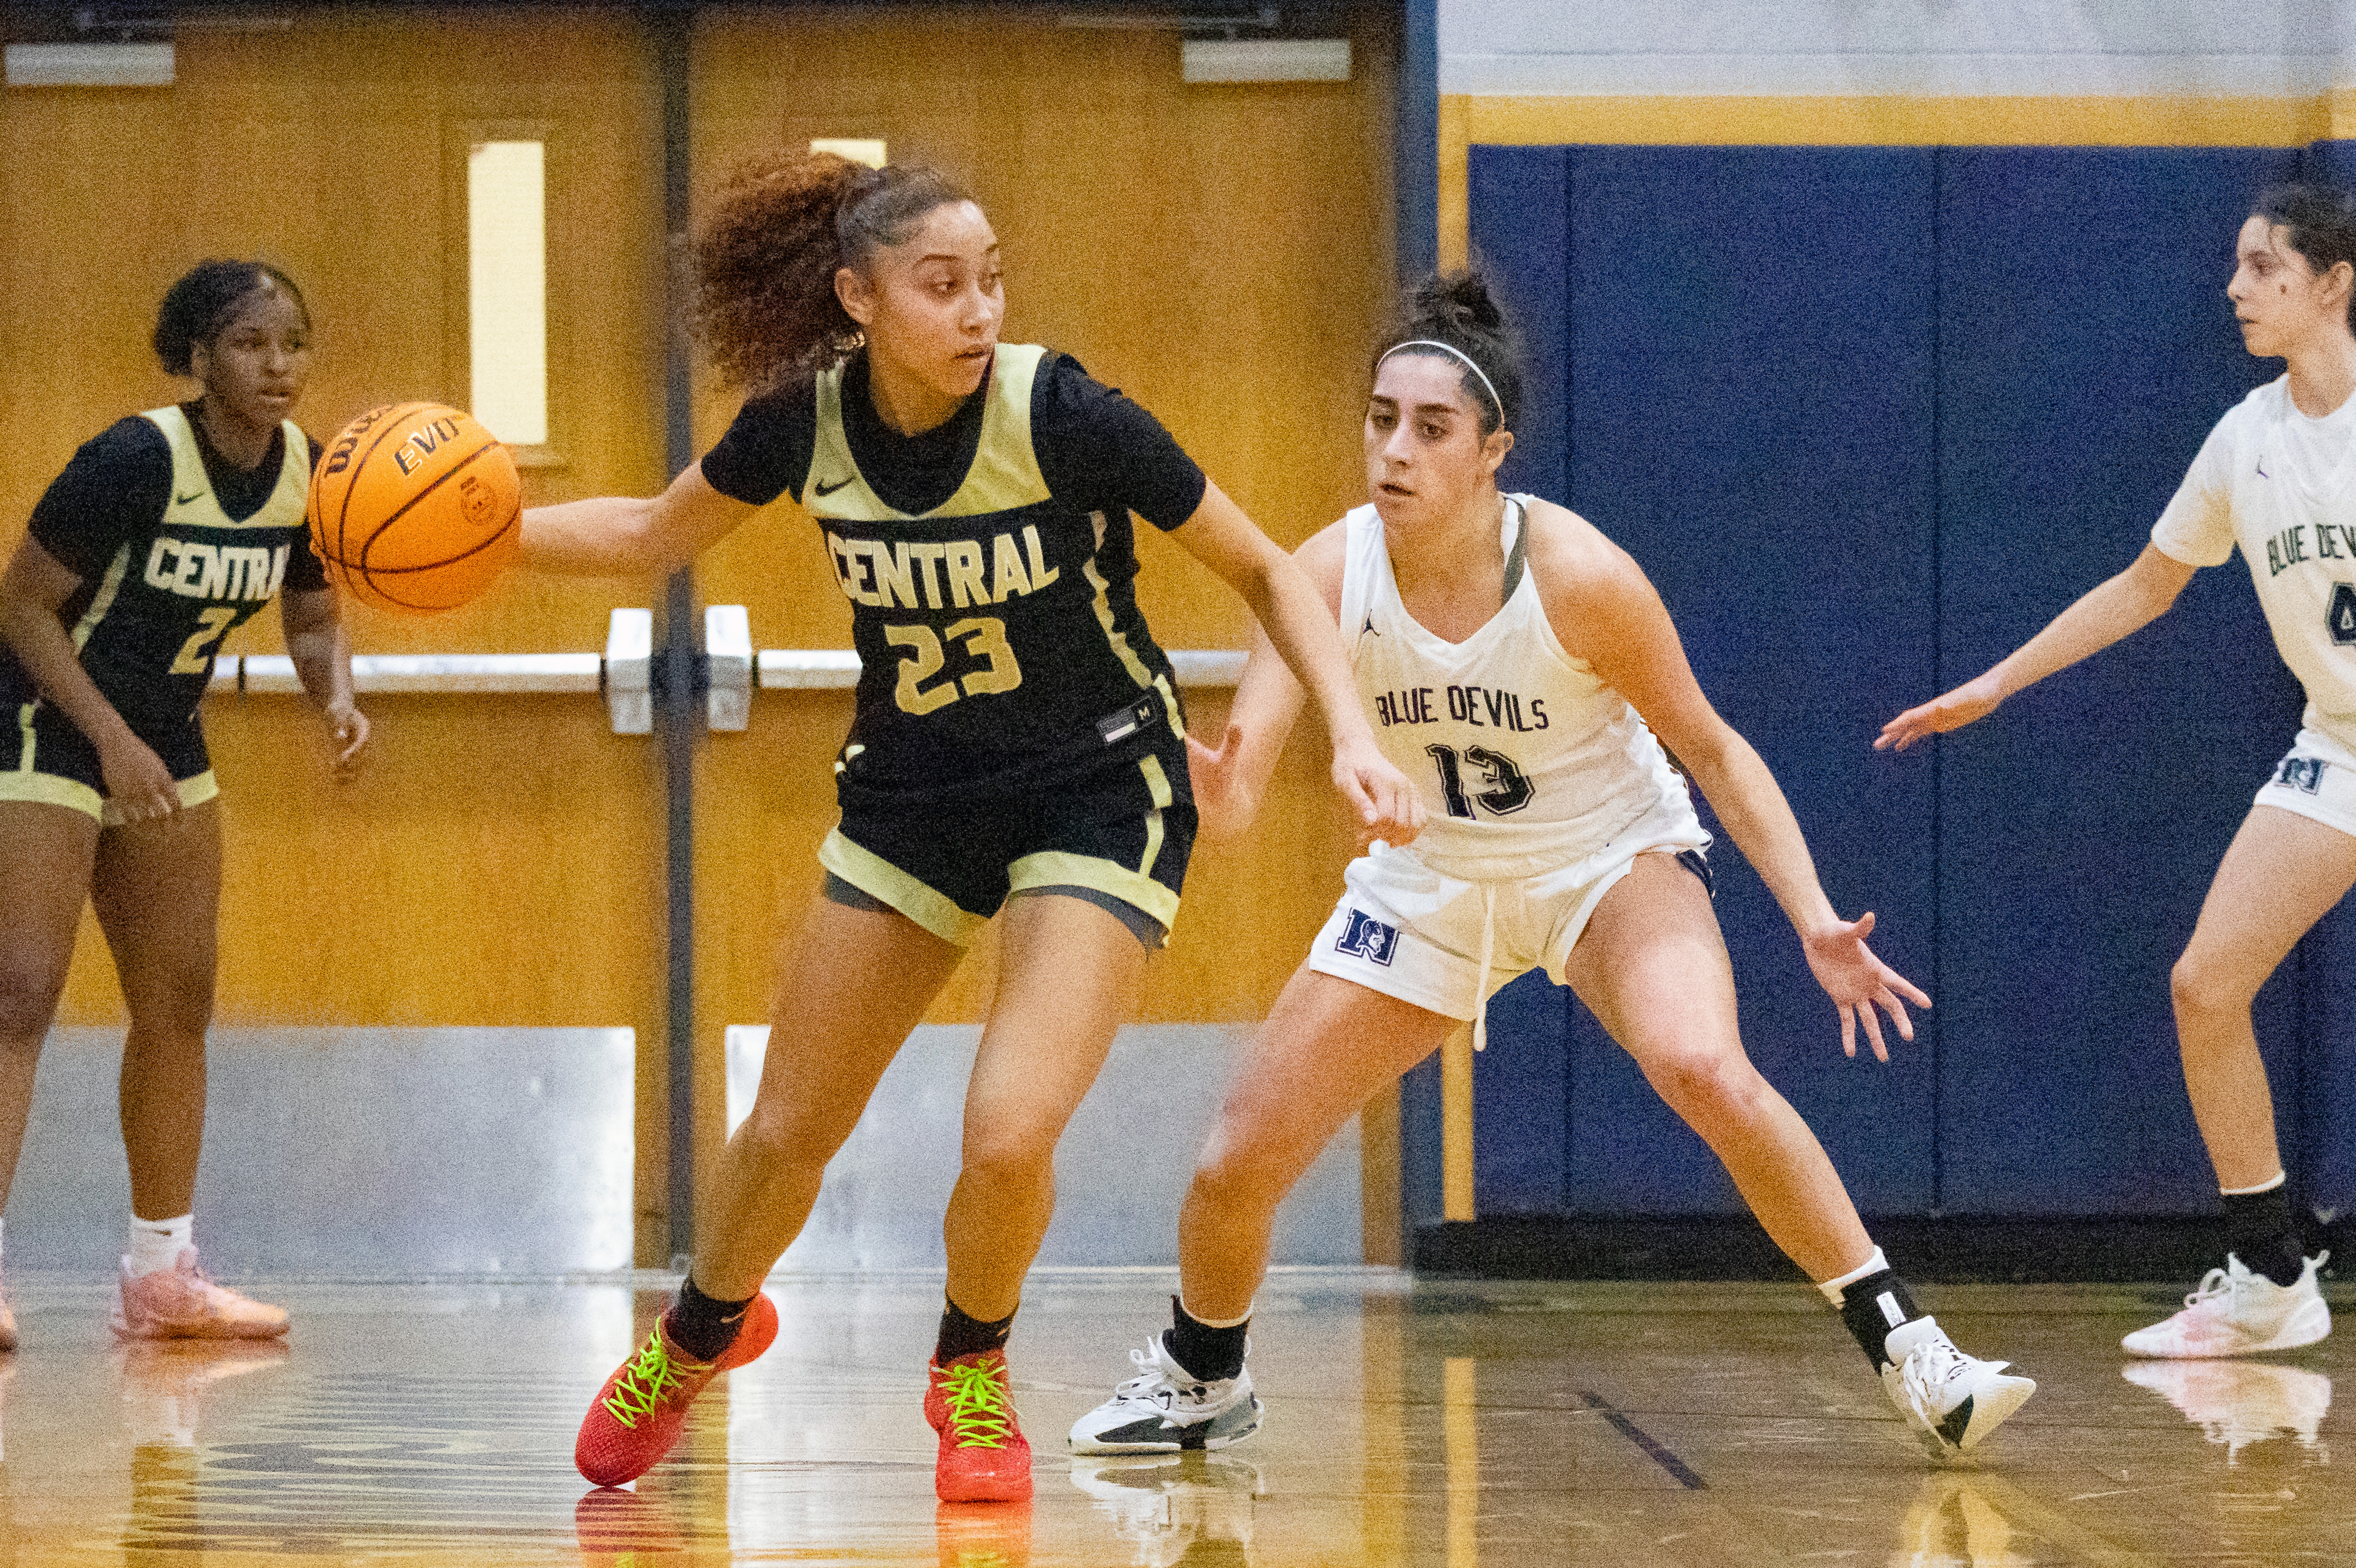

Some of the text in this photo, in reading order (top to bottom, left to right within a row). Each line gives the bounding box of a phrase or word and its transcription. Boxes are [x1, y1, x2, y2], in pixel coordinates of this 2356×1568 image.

[828, 525, 1060, 610] CENTRAL
[2267, 525, 2310, 577] BLUE
[169, 608, 237, 674] 2
[884, 617, 1023, 715] 23
[1139, 706, 1150, 720] M
[1375, 685, 1549, 732] BLUE DEVILS
[1424, 743, 1536, 820] 13
